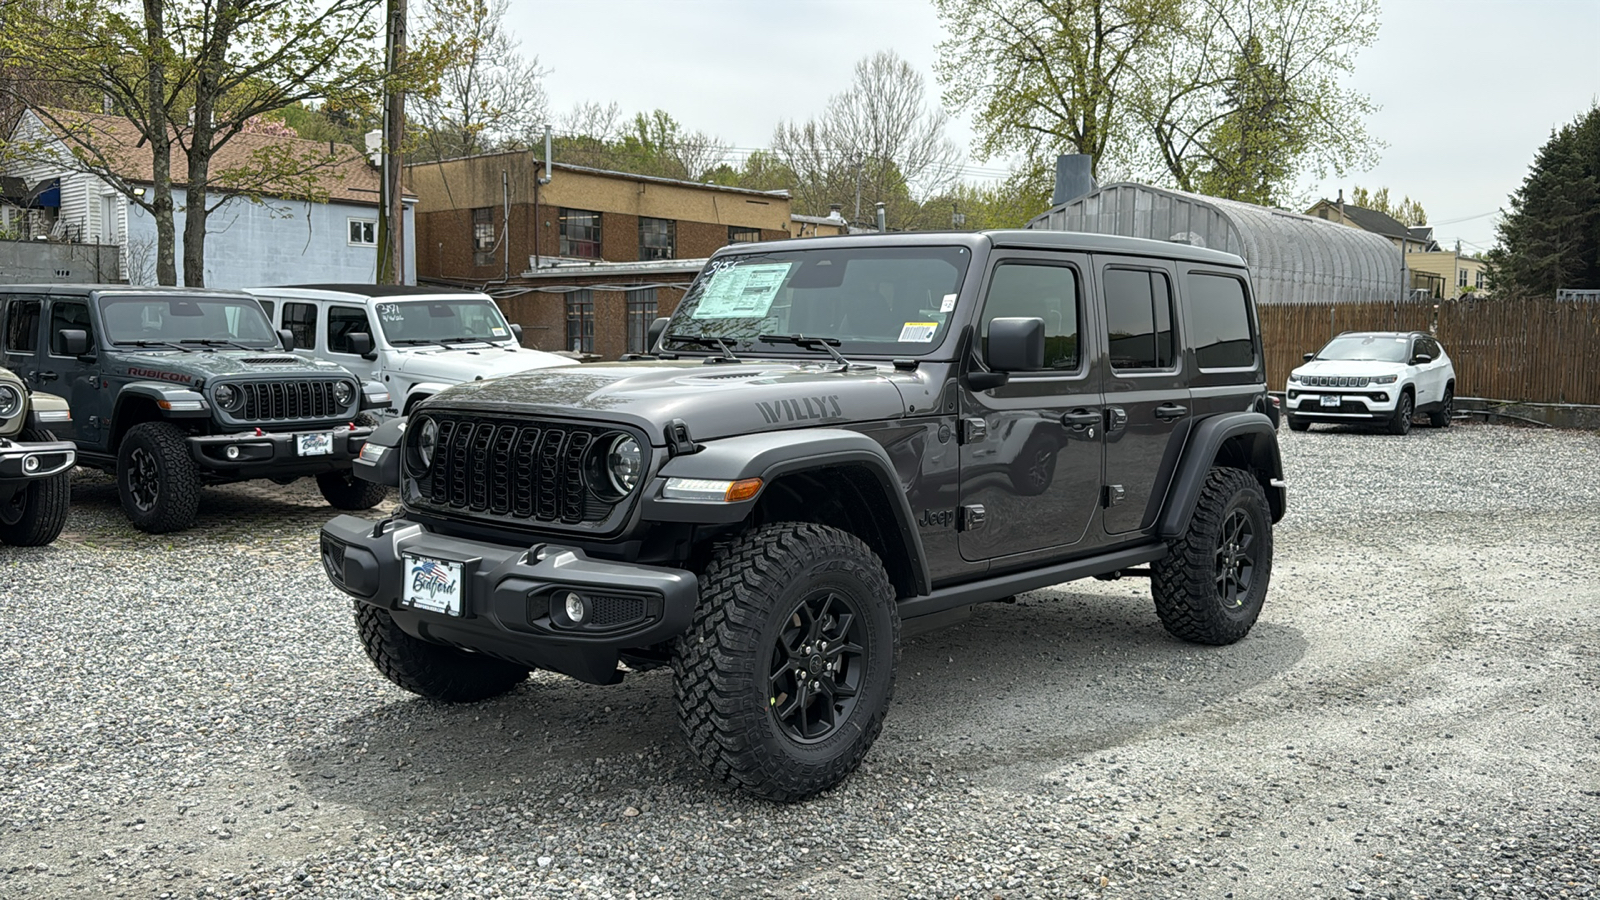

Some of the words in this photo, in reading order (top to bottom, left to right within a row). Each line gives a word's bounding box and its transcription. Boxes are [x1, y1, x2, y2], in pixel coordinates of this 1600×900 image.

[705, 261, 744, 275] 3155
[127, 367, 192, 383] RUBICON
[755, 395, 842, 423] WILLYS
[919, 508, 953, 527] Jeep
[412, 566, 456, 598] Bedford
